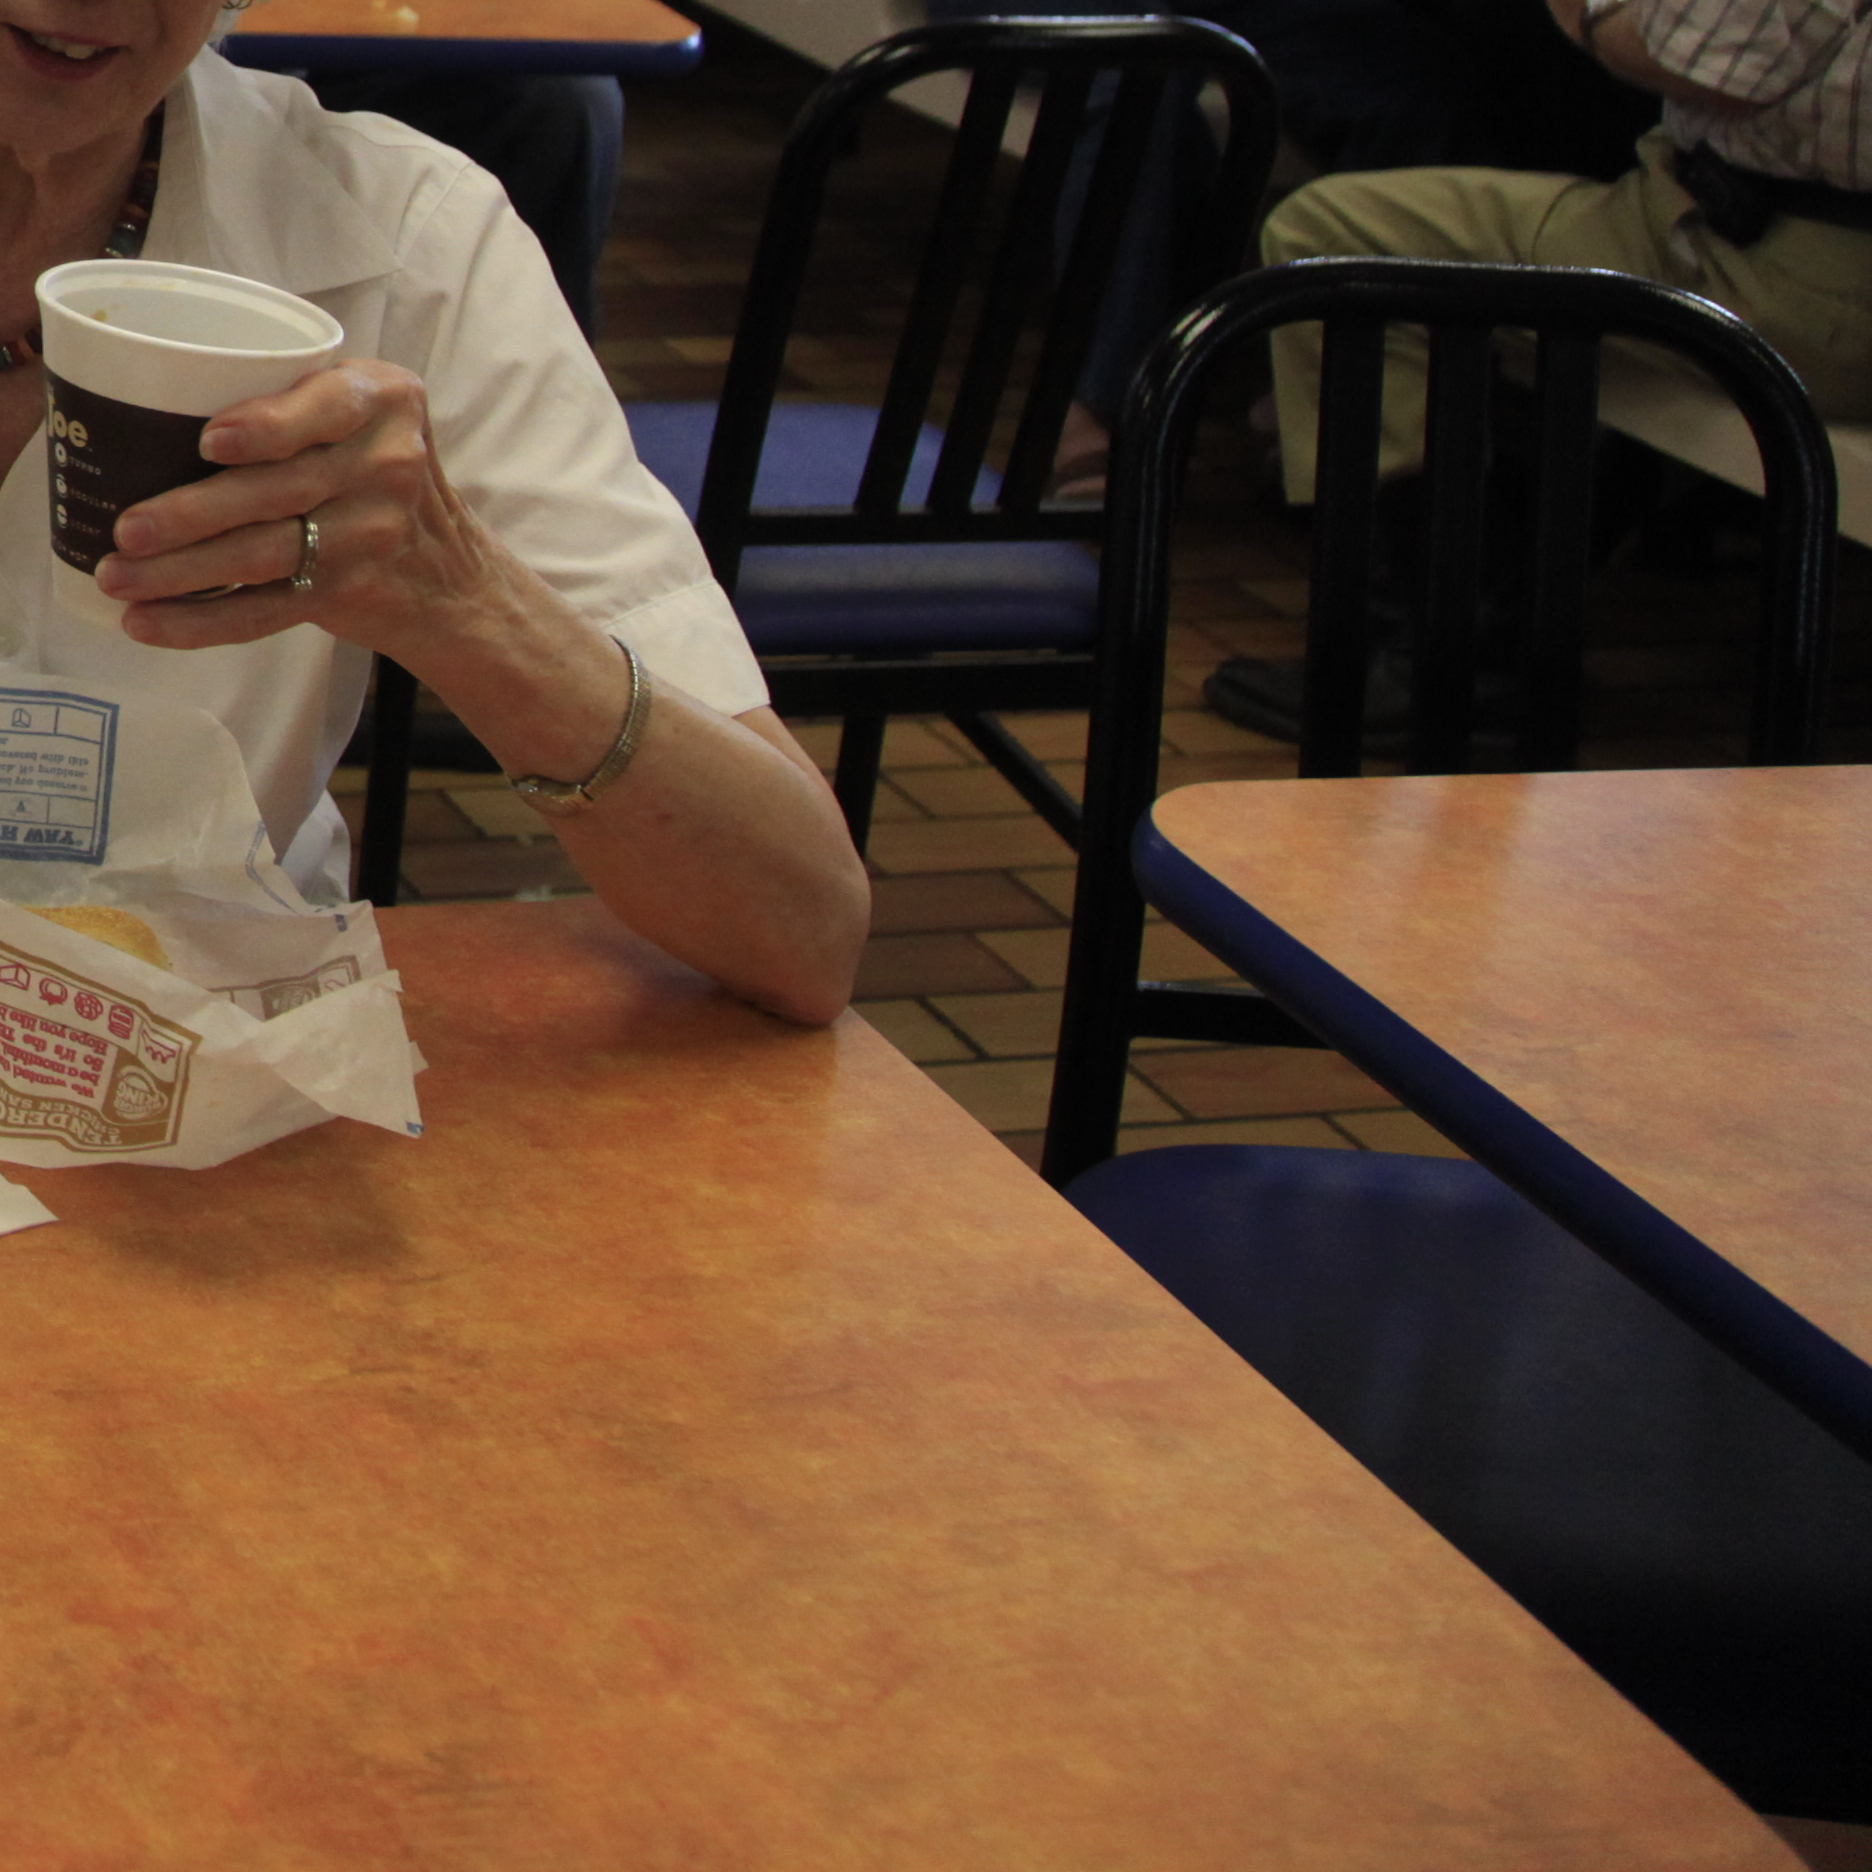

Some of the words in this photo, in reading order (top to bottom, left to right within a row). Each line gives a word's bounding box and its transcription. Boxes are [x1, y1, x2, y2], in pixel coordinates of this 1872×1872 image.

[10, 1012, 37, 1032] like
[39, 1021, 66, 1039] you
[23, 1034, 47, 1052] the
[69, 1032, 108, 1056] Hope
[54, 1044, 76, 1063] it's
[67, 1066, 78, 1077] a
[83, 1054, 104, 1072] So
[14, 1064, 66, 1087] wanted
[80, 1071, 100, 1086] be
[71, 1084, 94, 1099] We
[116, 1081, 154, 1106] KING
[37, 1100, 121, 1135] CHICKEN
